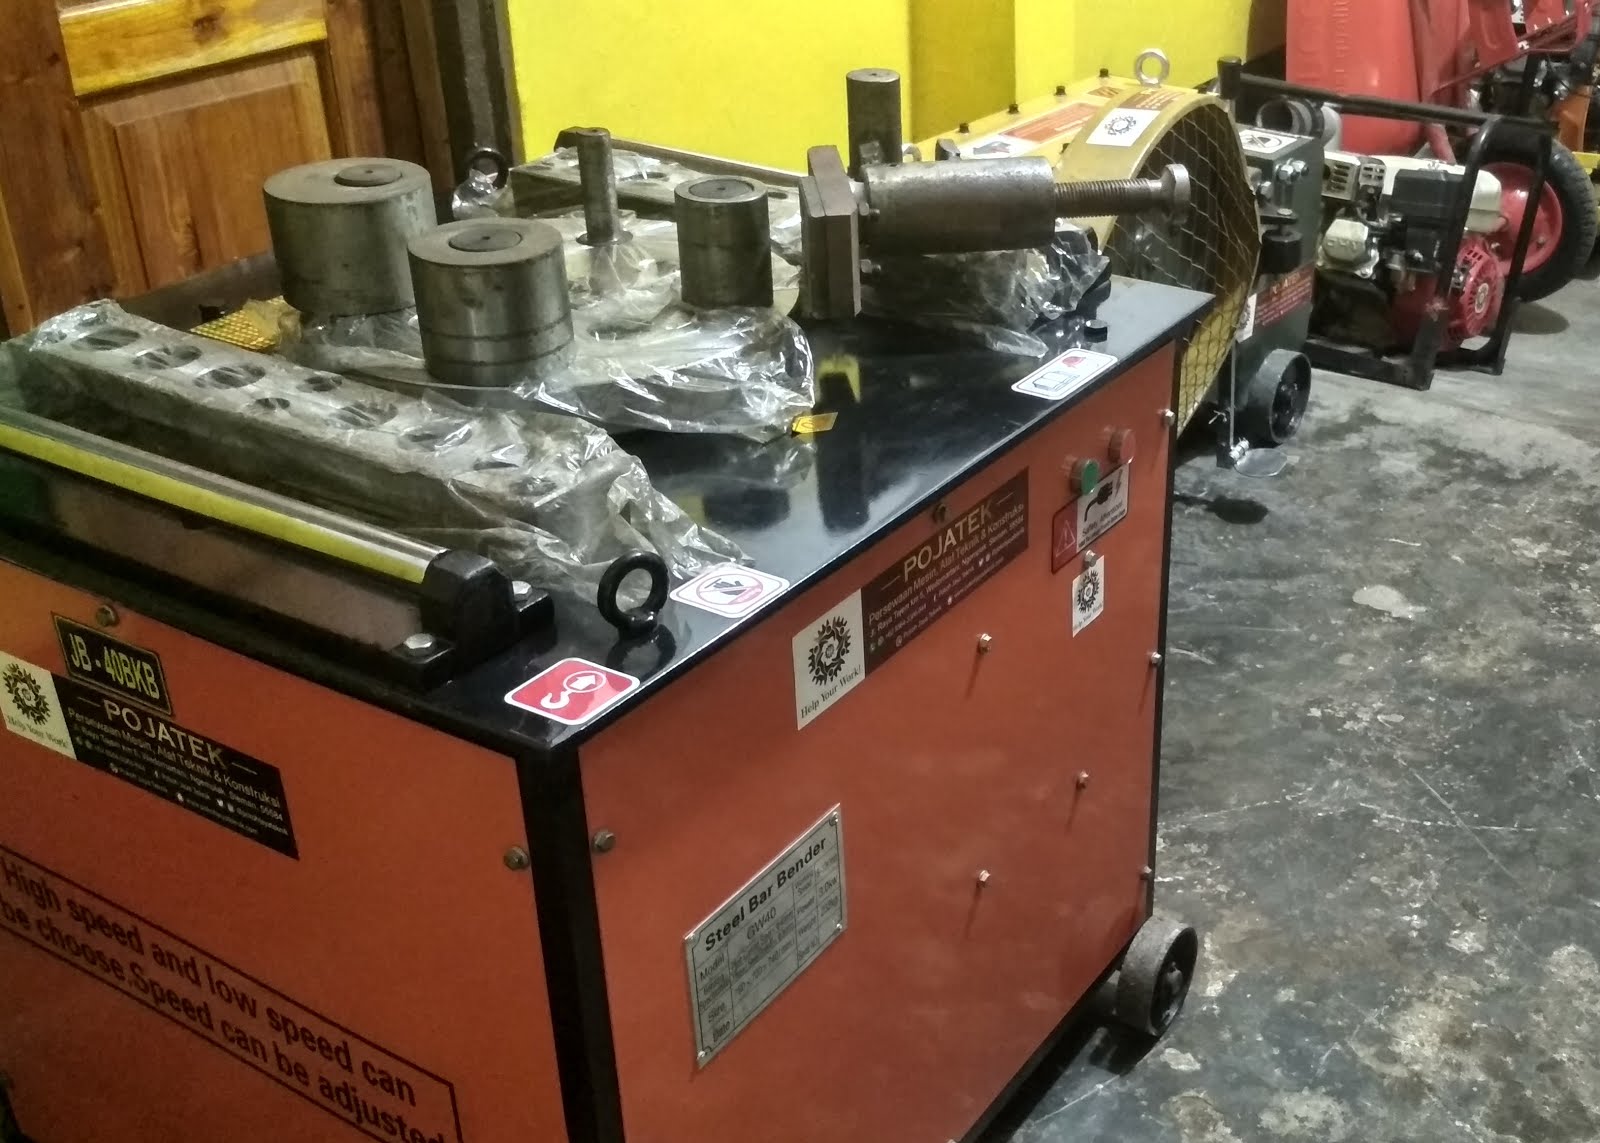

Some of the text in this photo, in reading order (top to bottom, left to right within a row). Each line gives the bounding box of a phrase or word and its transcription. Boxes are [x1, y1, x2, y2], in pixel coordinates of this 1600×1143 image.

[904, 502, 992, 582] POJATEK
[956, 532, 978, 559] Teknik
[980, 526, 985, 541] &
[801, 664, 861, 718] Help Your Work!
[103, 699, 228, 769] POJATEK
[212, 768, 222, 783] &
[704, 904, 744, 953] Steel
[748, 879, 773, 914] Bar
[776, 837, 826, 890] Bender
[746, 906, 776, 941] GW40
[0, 857, 416, 1107] High speed and low speed can
[0, 897, 31, 930] be
[221, 1020, 267, 1062] can
[272, 1041, 310, 1086] be
[700, 952, 724, 982] Model
